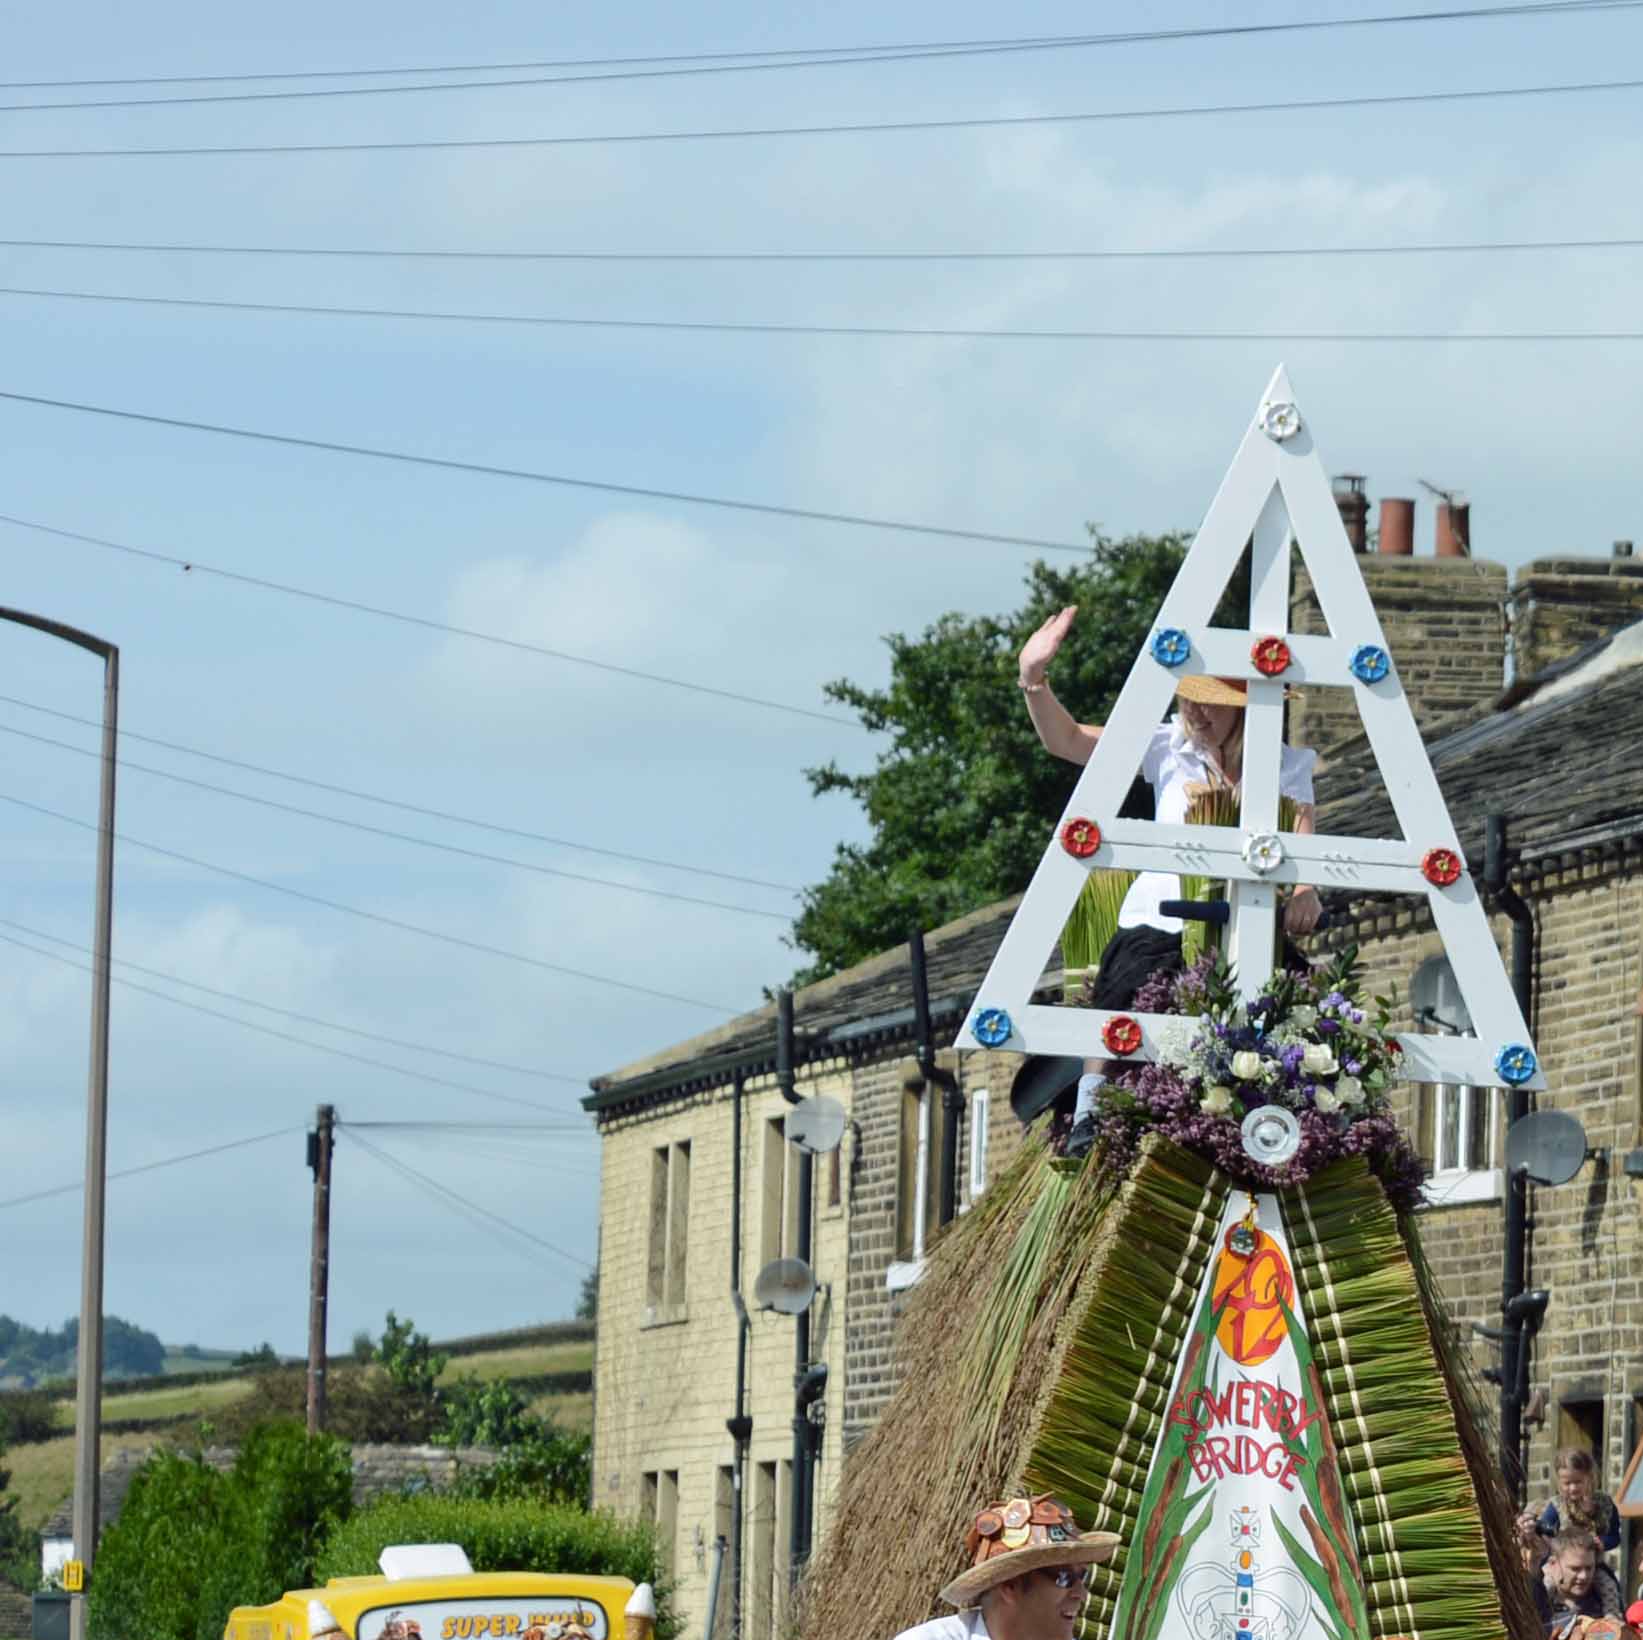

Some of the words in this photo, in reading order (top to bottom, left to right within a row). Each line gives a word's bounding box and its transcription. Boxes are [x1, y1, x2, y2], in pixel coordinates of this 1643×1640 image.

[1170, 1380, 1323, 1442] SOWERBY
[1187, 1434, 1307, 1492] BRIDGE
[441, 1614, 521, 1639] SUPER
